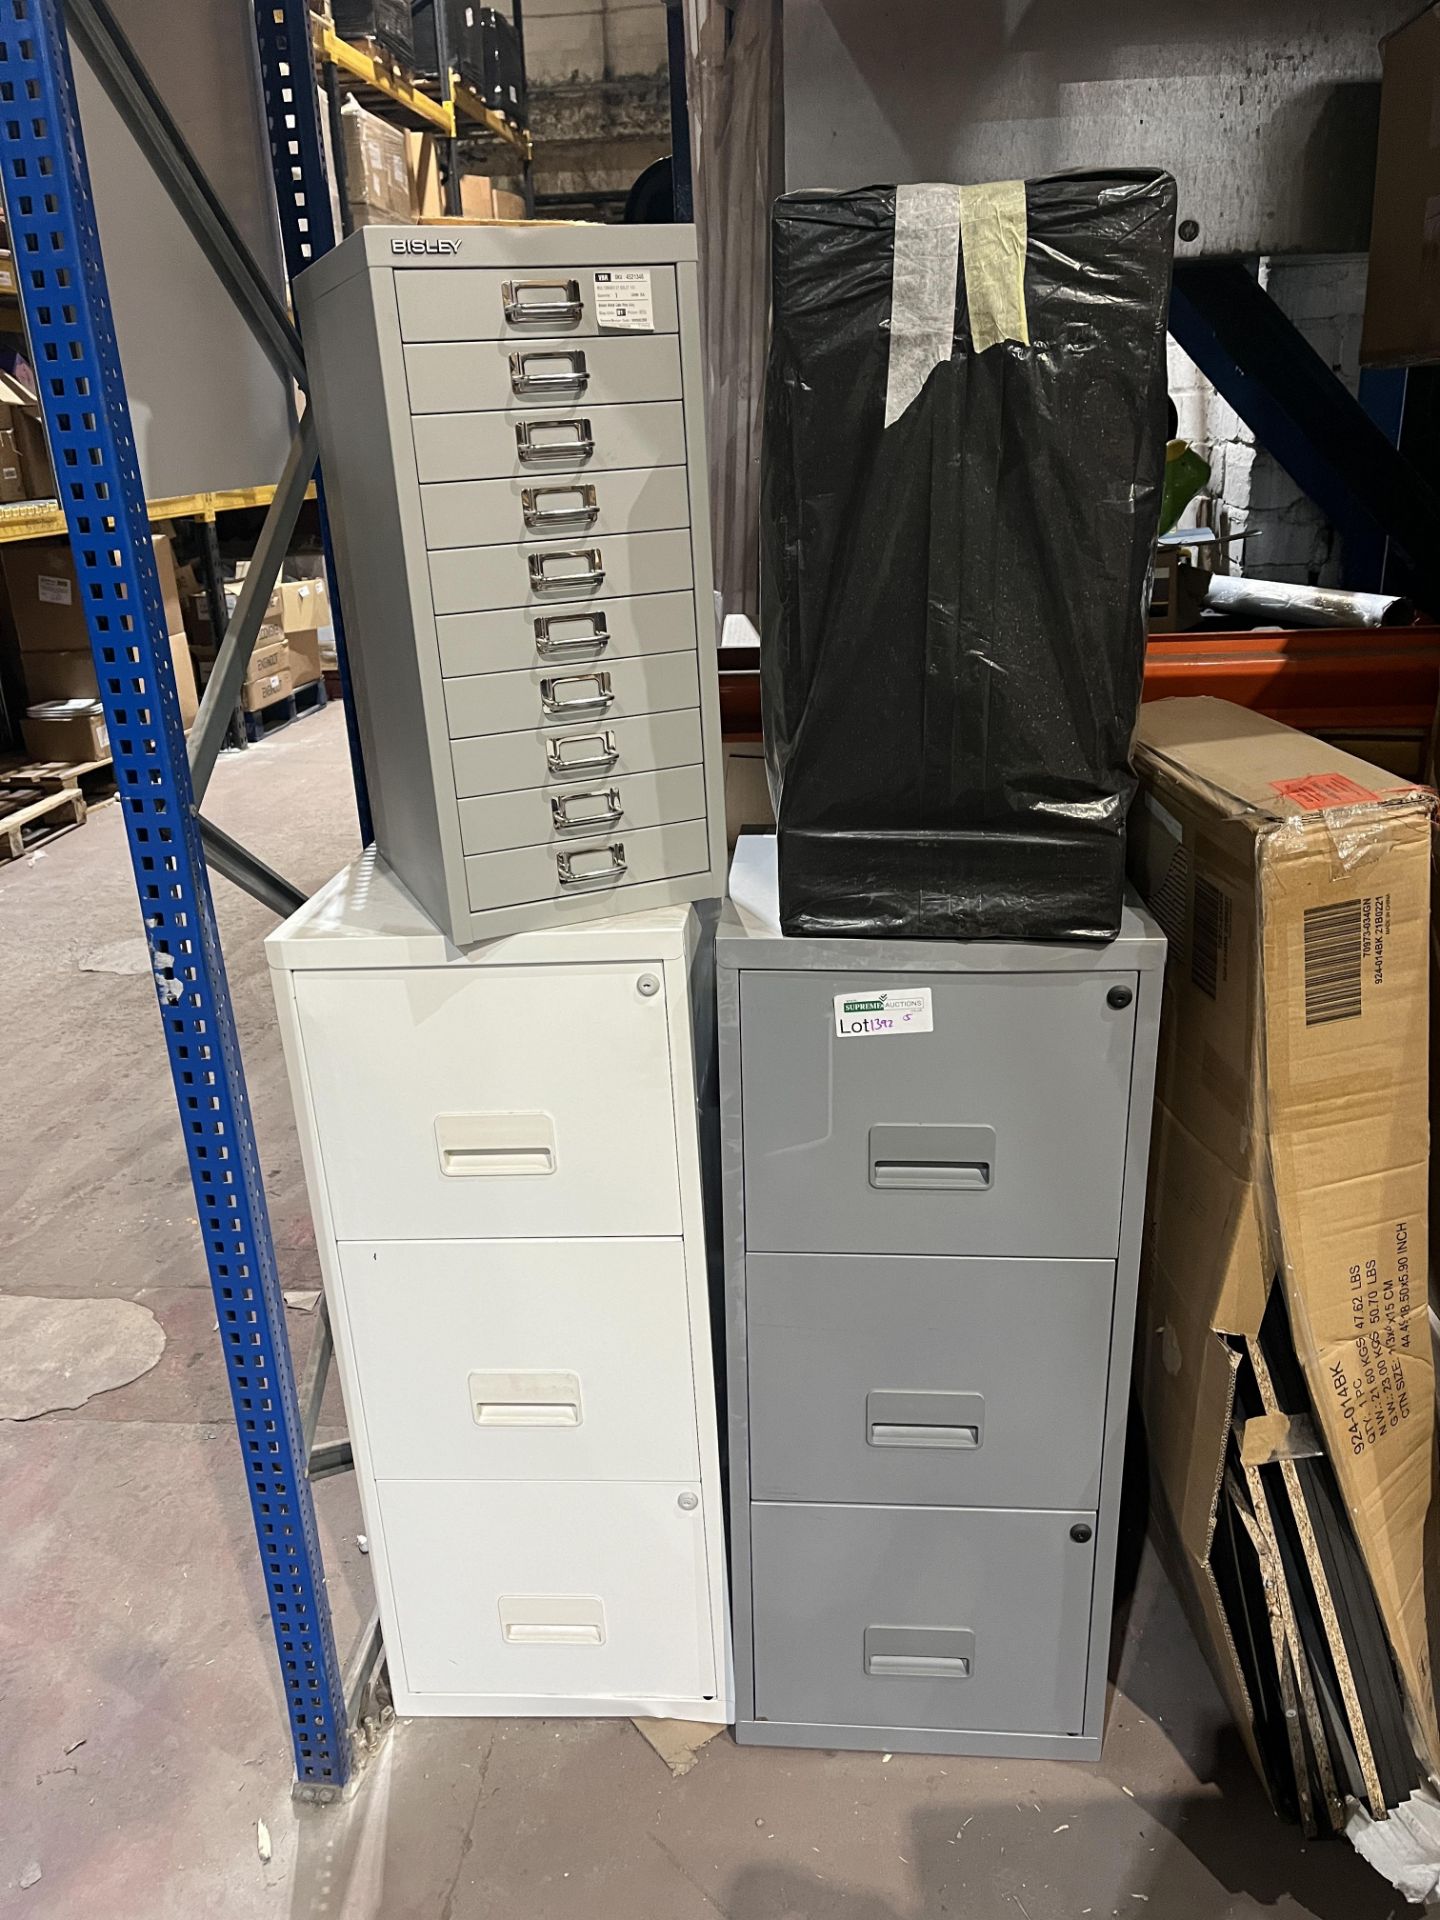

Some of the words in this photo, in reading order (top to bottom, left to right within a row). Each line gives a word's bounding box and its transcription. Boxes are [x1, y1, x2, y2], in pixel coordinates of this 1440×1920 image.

[391, 239, 462, 254] BISLEY
[1363, 897, 1371, 958] 70973-034GN
[1375, 896, 1383, 934] 21B0221
[1374, 937, 1383, 985] 924-014BK
[845, 1002, 882, 1012] SUPREME
[885, 1000, 922, 1009] AUCTIONS
[840, 1018, 869, 1034] Lot
[1396, 1222, 1407, 1255] INCH
[1349, 1264, 1361, 1291] LBS
[1366, 1259, 1377, 1285] LBS
[1383, 1280, 1394, 1300] CM
[1352, 1295, 1364, 1329] 47.62
[1367, 1290, 1379, 1324] 50.70
[1356, 1337, 1371, 1367] KGS
[1353, 1378, 1364, 1399] PC
[1365, 1368, 1380, 1402] 21.60
[1377, 1360, 1392, 1393] 23.00
[1392, 1356, 1405, 1391] SIZE:
[1329, 1360, 1365, 1455] 924-014BK
[1360, 1399, 1367, 1408] 1
[1398, 1392, 1410, 1419] CTN
[1363, 1412, 1376, 1444] QTY:
